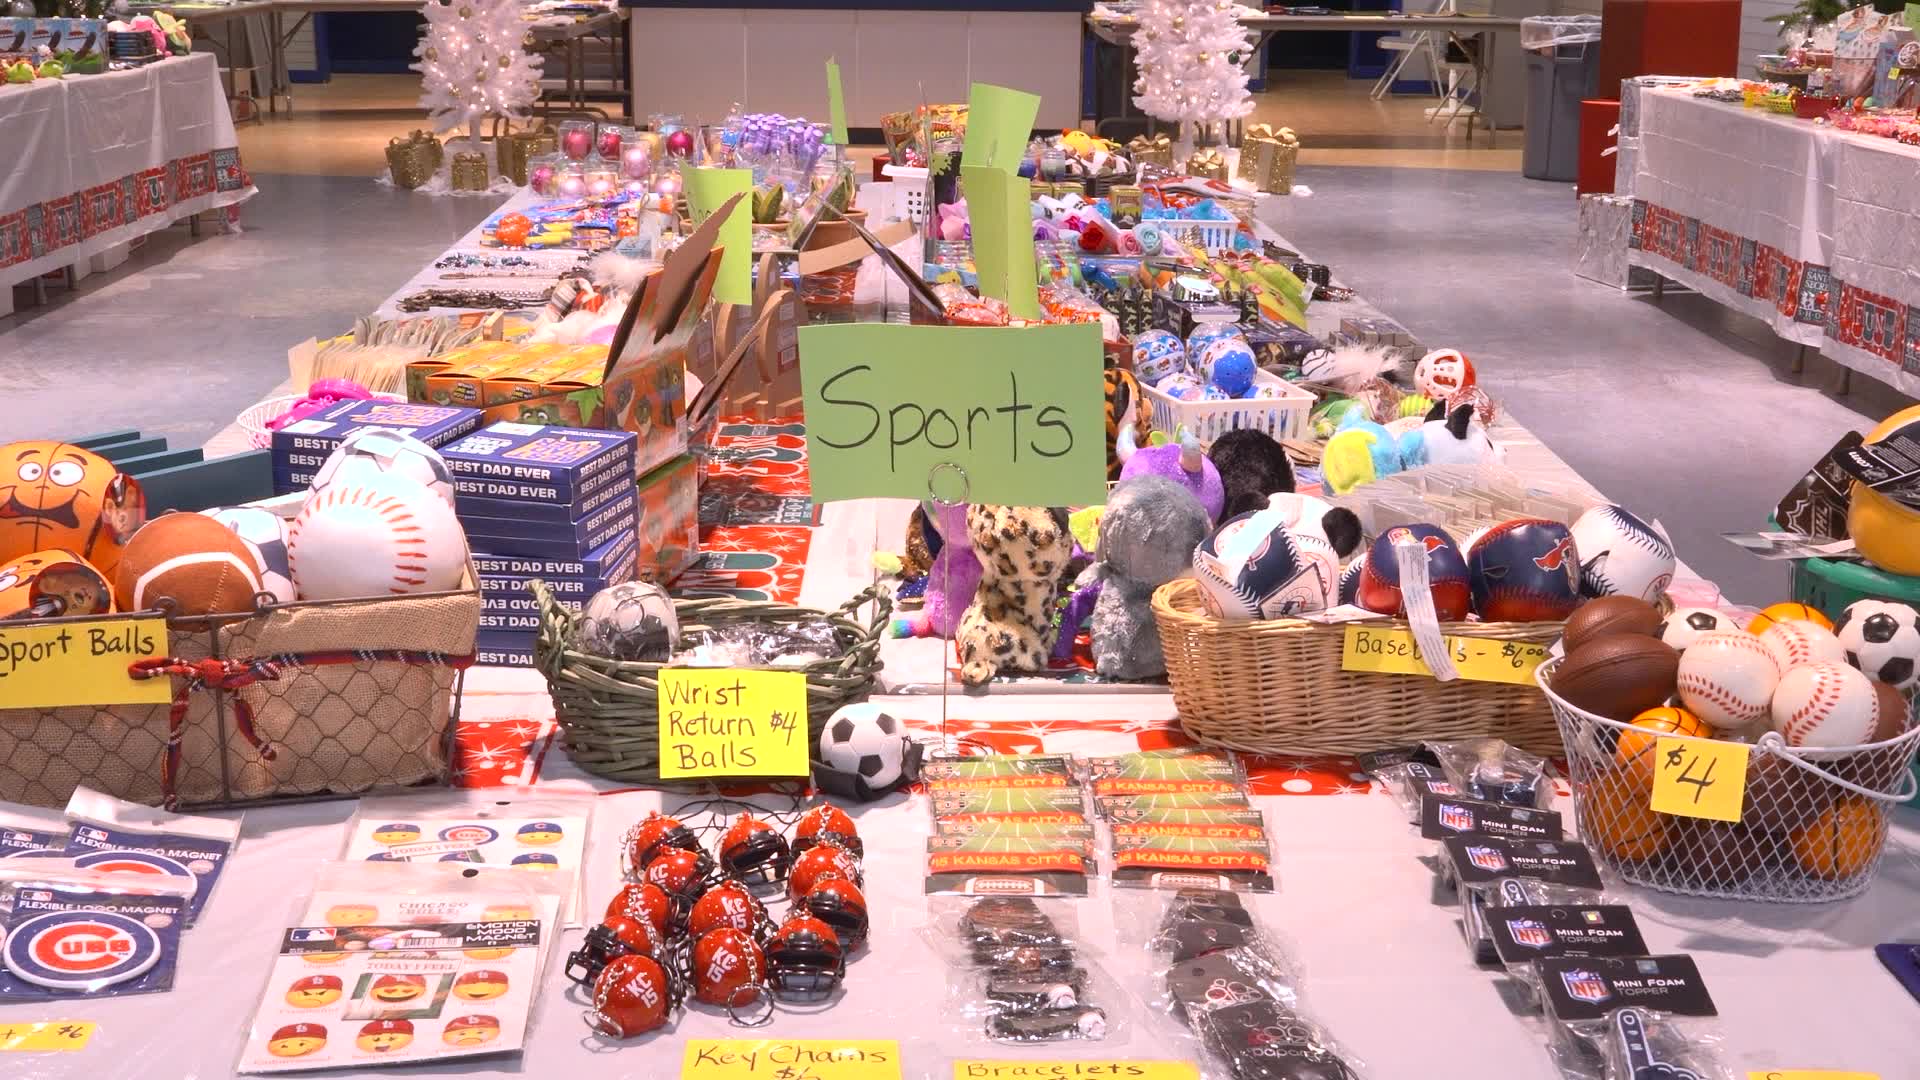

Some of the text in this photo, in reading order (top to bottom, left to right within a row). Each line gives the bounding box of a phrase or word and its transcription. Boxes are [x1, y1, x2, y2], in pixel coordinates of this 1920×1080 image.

[1807, 271, 1828, 282] SANT
[816, 365, 1073, 472] Sports
[294, 438, 328, 449] BEST
[289, 455, 324, 466] BEST
[580, 445, 629, 477] BEST DAD EVER
[447, 461, 550, 479] BEST DAD EVER
[580, 460, 628, 494] BEST DAD EVER
[291, 473, 315, 484] BES
[455, 482, 557, 499] BEST DAD EVER
[582, 478, 630, 512] BEST DAD EVER
[587, 497, 632, 531] BEST DAD EVER
[589, 514, 634, 549] BEST DAD EVER
[475, 561, 584, 573] BEST DAD EVER
[480, 580, 508, 590] EST
[511, 581, 529, 590] DA
[481, 599, 507, 609] EVE
[479, 616, 539, 627] EST DAD
[88, 625, 155, 656] Balls
[477, 653, 533, 664] EST DA
[664, 678, 746, 706] Wrist
[670, 710, 797, 746] Return $4
[672, 740, 756, 770] Balls
[1664, 744, 1717, 804] $4
[946, 779, 1009, 789] KANSAS
[1014, 778, 1047, 787] CITY
[1116, 783, 1176, 791] KANSAS
[1182, 784, 1214, 792] CITY
[1444, 813, 1474, 830] NFL
[1481, 820, 1545, 834] MINI FOAM
[1136, 827, 1201, 836] KANSAS
[1208, 828, 1244, 837] CITY
[75, 836, 124, 850] FLEXIBLE
[168, 849, 222, 861] MAGNET
[953, 856, 1020, 865] KANSAS
[1027, 855, 1063, 865] CITY
[1136, 853, 1203, 864] KANSAS
[1209, 856, 1245, 865] CITY
[1473, 854, 1505, 870] NFL
[1512, 856, 1538, 864] MINI
[650, 864, 668, 880] KC
[19, 900, 179, 914] FLEXIBLE LOGO MAGNET
[721, 896, 746, 915] KC
[731, 914, 747, 929] 15
[466, 933, 537, 942] MAGNET
[476, 927, 527, 935] MOOD
[1517, 929, 1553, 945] NFL
[1588, 928, 1623, 937] FOAM
[1560, 936, 1607, 944] TOPPER
[712, 947, 738, 971] KC
[706, 963, 725, 984] 15
[626, 972, 652, 998] KC
[1571, 980, 1610, 999] NFL
[1613, 978, 1685, 988] MINI FOAM
[640, 988, 659, 1009] 15
[1616, 986, 1669, 996] TOPPER
[694, 1046, 757, 1071] Key
[967, 1063, 1145, 1077] Bracelets
